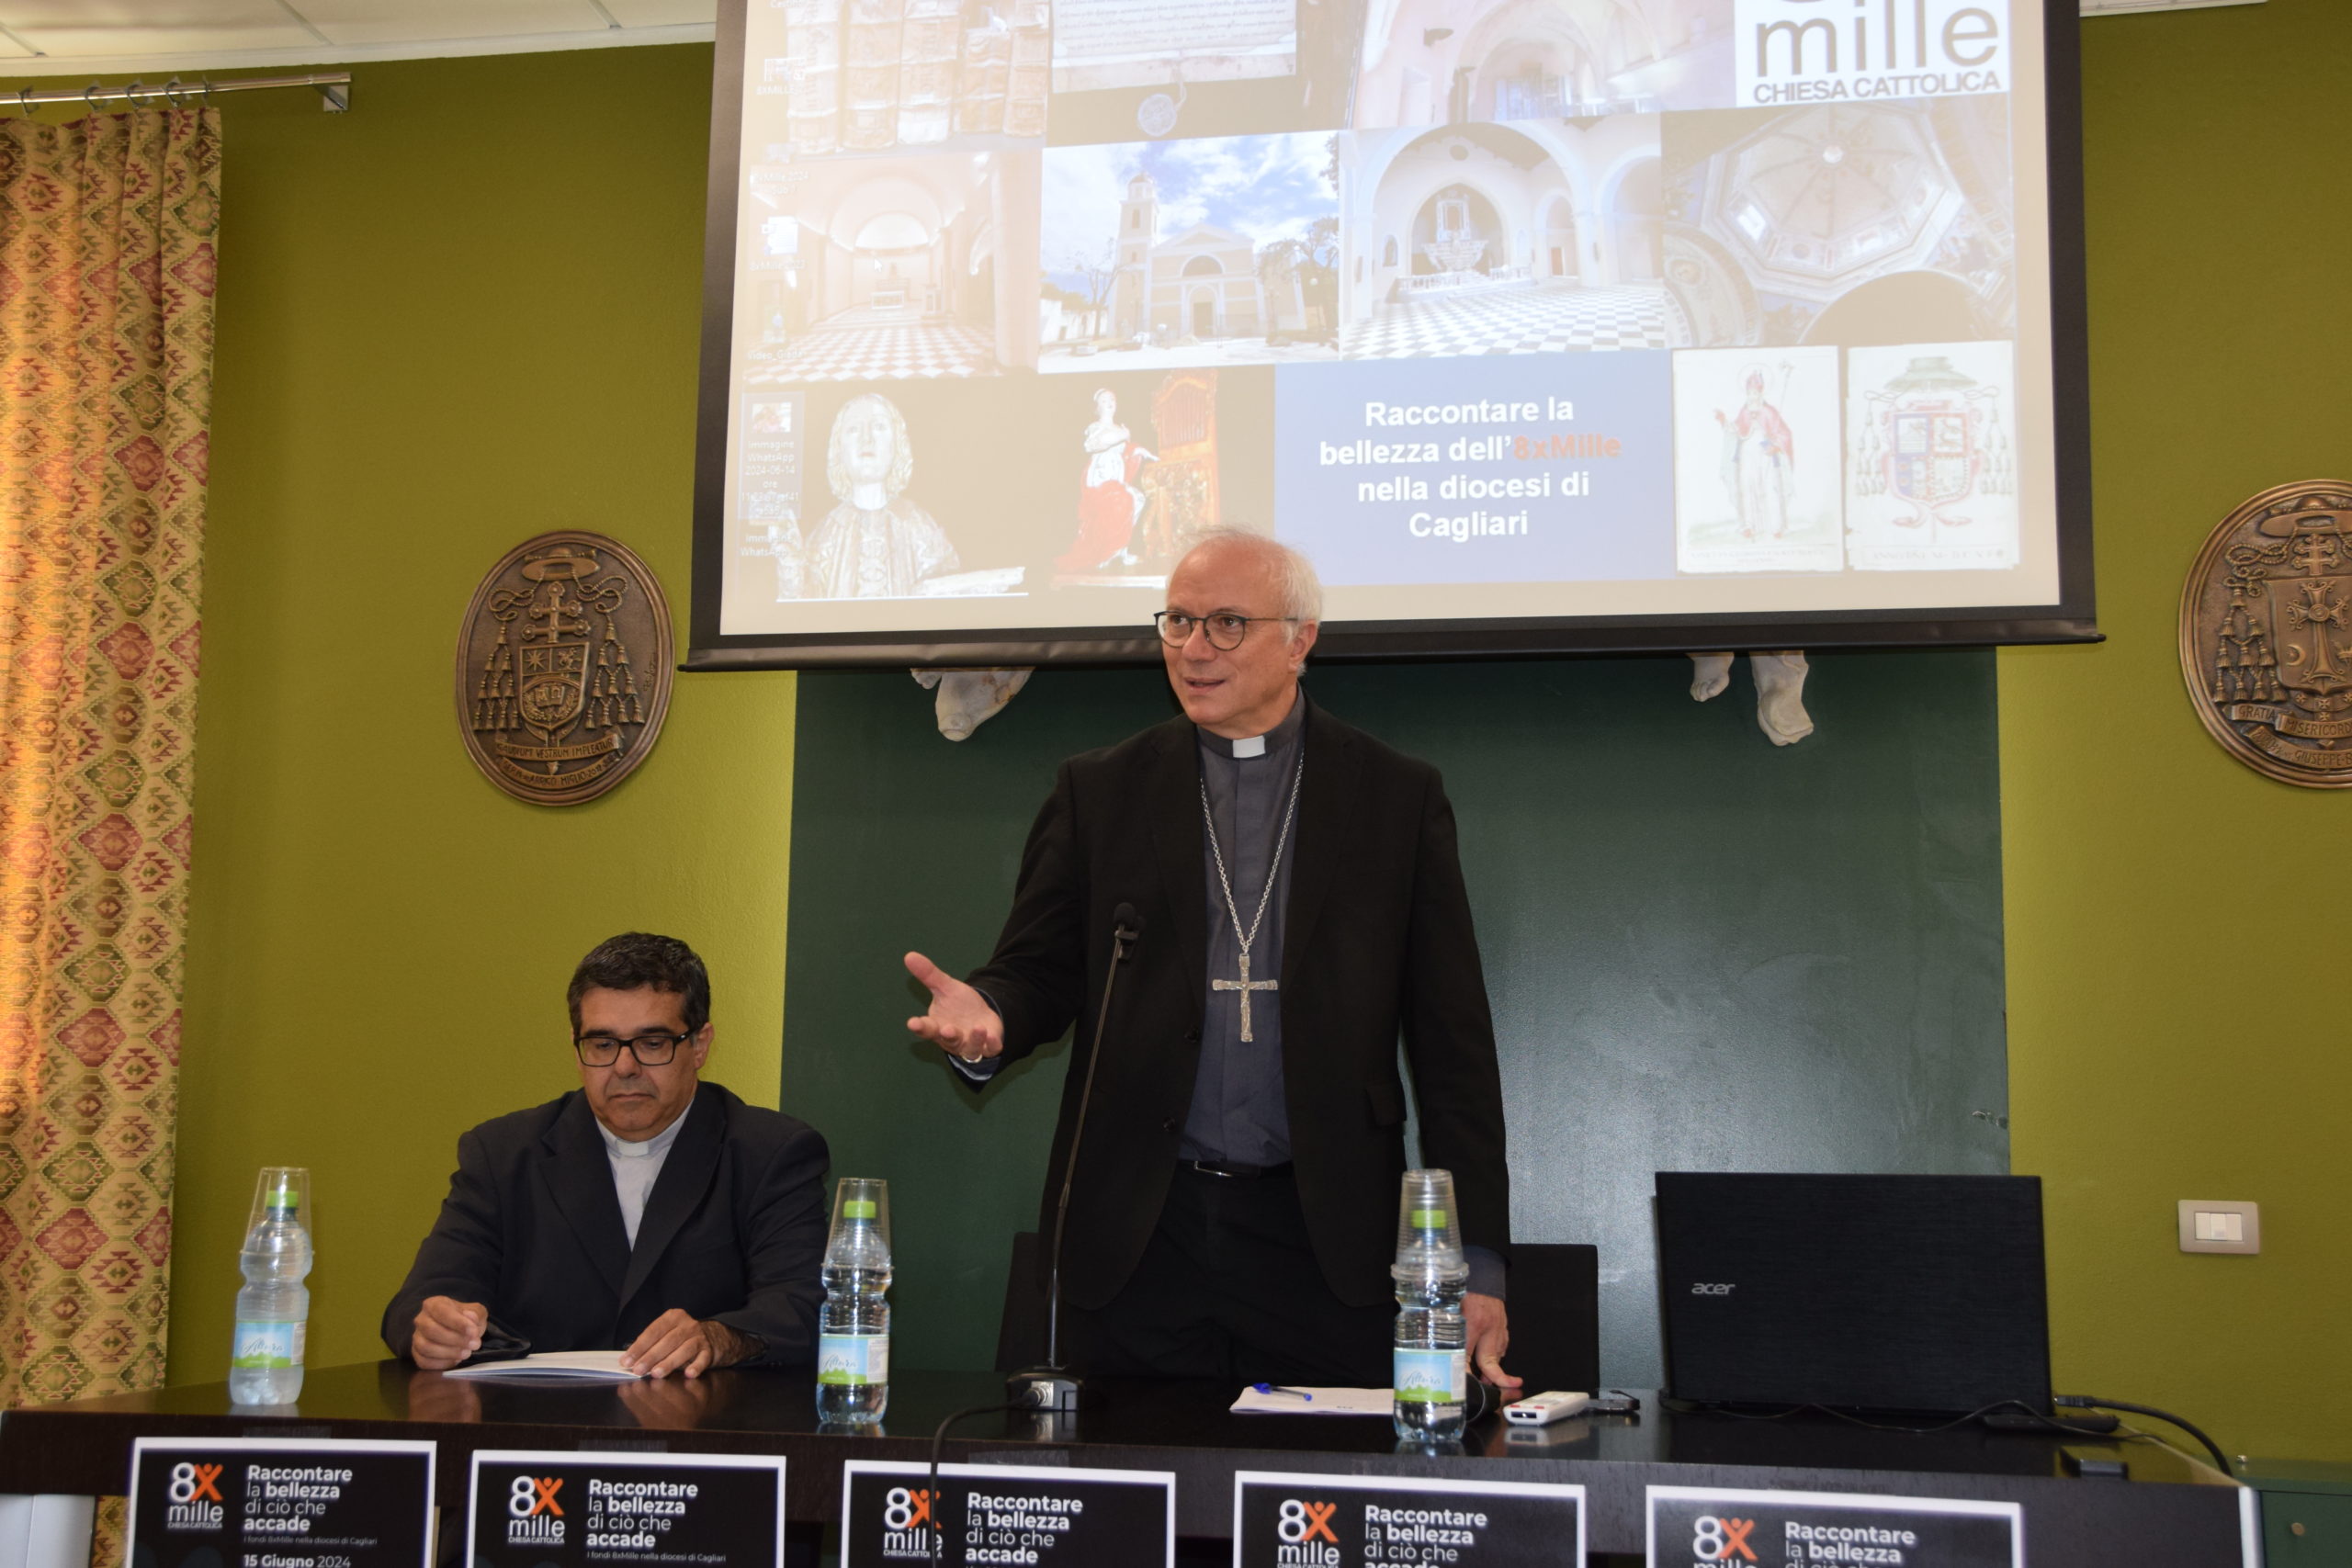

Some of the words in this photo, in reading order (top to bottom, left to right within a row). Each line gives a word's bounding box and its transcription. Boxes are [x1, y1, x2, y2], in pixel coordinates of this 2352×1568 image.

[1756, 0, 1998, 77] mille
[1754, 79, 1849, 104] CHIESA
[1853, 71, 2001, 97] CATTOLICA
[1365, 399, 1539, 426] Raccontare
[1548, 397, 1574, 421] la
[1320, 440, 1440, 465] bellezza
[1358, 476, 1429, 502] nella
[1440, 473, 1550, 500] diocesi
[1561, 471, 1589, 497] di
[1409, 511, 1528, 543] Cagliari
[2239, 705, 2275, 721] GRATIA
[537, 749, 569, 759] VESTRUM
[1691, 1283, 1736, 1295] acer
[247, 1465, 353, 1482] Raccontare
[246, 1482, 260, 1498] la
[266, 1482, 341, 1499] bellezza
[589, 1479, 698, 1497] Raccontare
[168, 1501, 223, 1523] mille
[245, 1498, 261, 1515] di
[266, 1498, 290, 1515] ciò
[295, 1499, 326, 1516] che
[588, 1496, 603, 1513] la
[608, 1496, 686, 1515] bellezza
[967, 1492, 1083, 1513] Raccontare
[243, 1516, 311, 1531] accade
[587, 1514, 604, 1529] di
[608, 1515, 635, 1530] ciò
[639, 1515, 672, 1531] che
[967, 1510, 982, 1527] la
[988, 1510, 1070, 1530] bellezza
[1365, 1504, 1487, 1527] Raccontare
[508, 1515, 566, 1539] mille
[966, 1527, 983, 1544] di
[989, 1529, 1015, 1545] ciò
[1021, 1529, 1055, 1547] che
[1365, 1523, 1381, 1540] la
[1386, 1524, 1475, 1545] bellezza
[1785, 1521, 1917, 1545] Raccontare
[247, 1535, 266, 1543] fondi
[295, 1536, 313, 1544] nella
[314, 1536, 340, 1544] diocesi
[341, 1536, 349, 1544] di
[350, 1537, 378, 1546] Cagliari
[587, 1530, 656, 1548] accade
[243, 1554, 258, 1567] 15
[261, 1553, 314, 1568] Giugno
[317, 1555, 351, 1568] 2024
[640, 1552, 660, 1561] nella
[661, 1552, 686, 1561] diocesi
[688, 1553, 696, 1562] di
[697, 1553, 726, 1563] Cagliari
[966, 1545, 1039, 1563] accade
[1278, 1540, 1340, 1565] mille
[1364, 1540, 1383, 1558] di
[1388, 1541, 1417, 1559] ciò
[1422, 1542, 1458, 1561] che
[1785, 1540, 1803, 1558] la
[1809, 1541, 1902, 1563] bellezza
